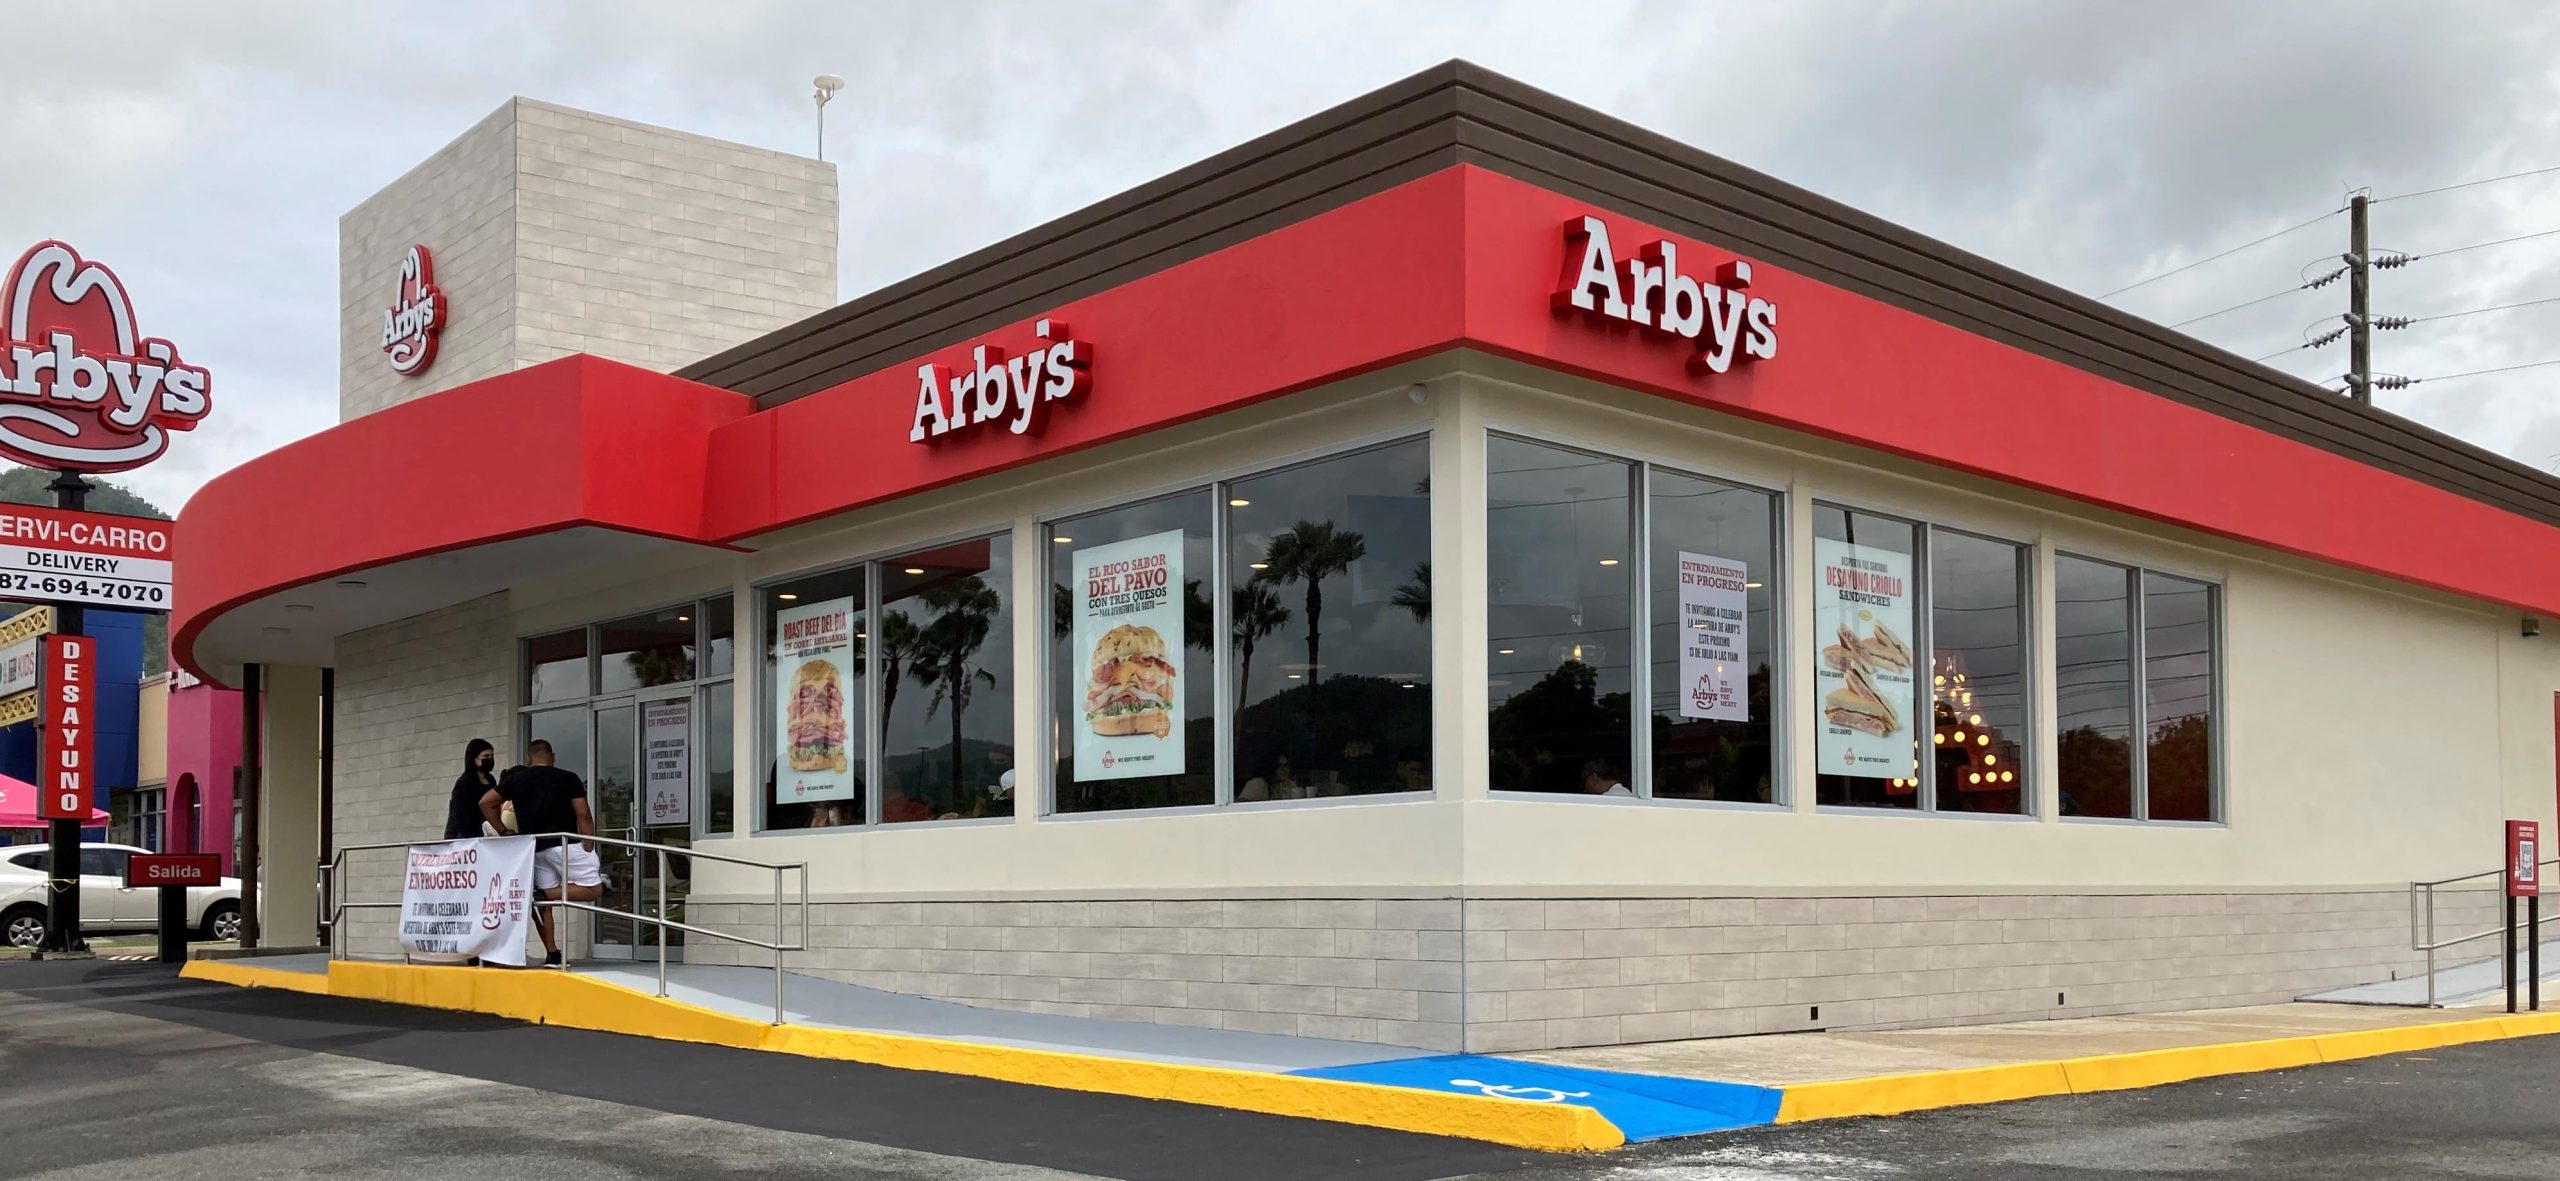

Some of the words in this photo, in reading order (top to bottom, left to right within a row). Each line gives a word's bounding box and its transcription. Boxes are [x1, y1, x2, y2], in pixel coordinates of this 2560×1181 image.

[1571, 214, 1778, 374] Arby's
[382, 287, 434, 348] Arby's
[910, 318, 1075, 443] Arby's
[27, 551, 119, 573] DELIVERY
[1089, 567, 1101, 579] EL
[1103, 561, 1129, 576] RICO
[1132, 554, 1167, 570] SABOR
[1682, 560, 1745, 579] ENTRENAMIENTO
[1088, 577, 1120, 598] DEL
[1124, 568, 1167, 592] PAVO
[1682, 572, 1694, 584] EN
[1697, 574, 1745, 592] PROGRESO
[1826, 565, 1869, 592] DESAYUNO
[1870, 573, 1902, 598] CRIOLLO
[1089, 597, 1107, 609] CON
[1109, 593, 1131, 605] TRES
[1133, 587, 1167, 602] QUESOS
[1839, 589, 1891, 607] SANDWICHES
[784, 620, 804, 640] ROAST
[805, 616, 820, 637] BEEF
[821, 614, 833, 633] DEL
[1699, 633, 1709, 645] ESTE
[1692, 688, 1718, 703] Arby's
[60, 641, 80, 812] DESAYUNO
[148, 864, 201, 878] Salida
[420, 870, 477, 890] PROGRESO
[481, 896, 505, 919] Arby's
